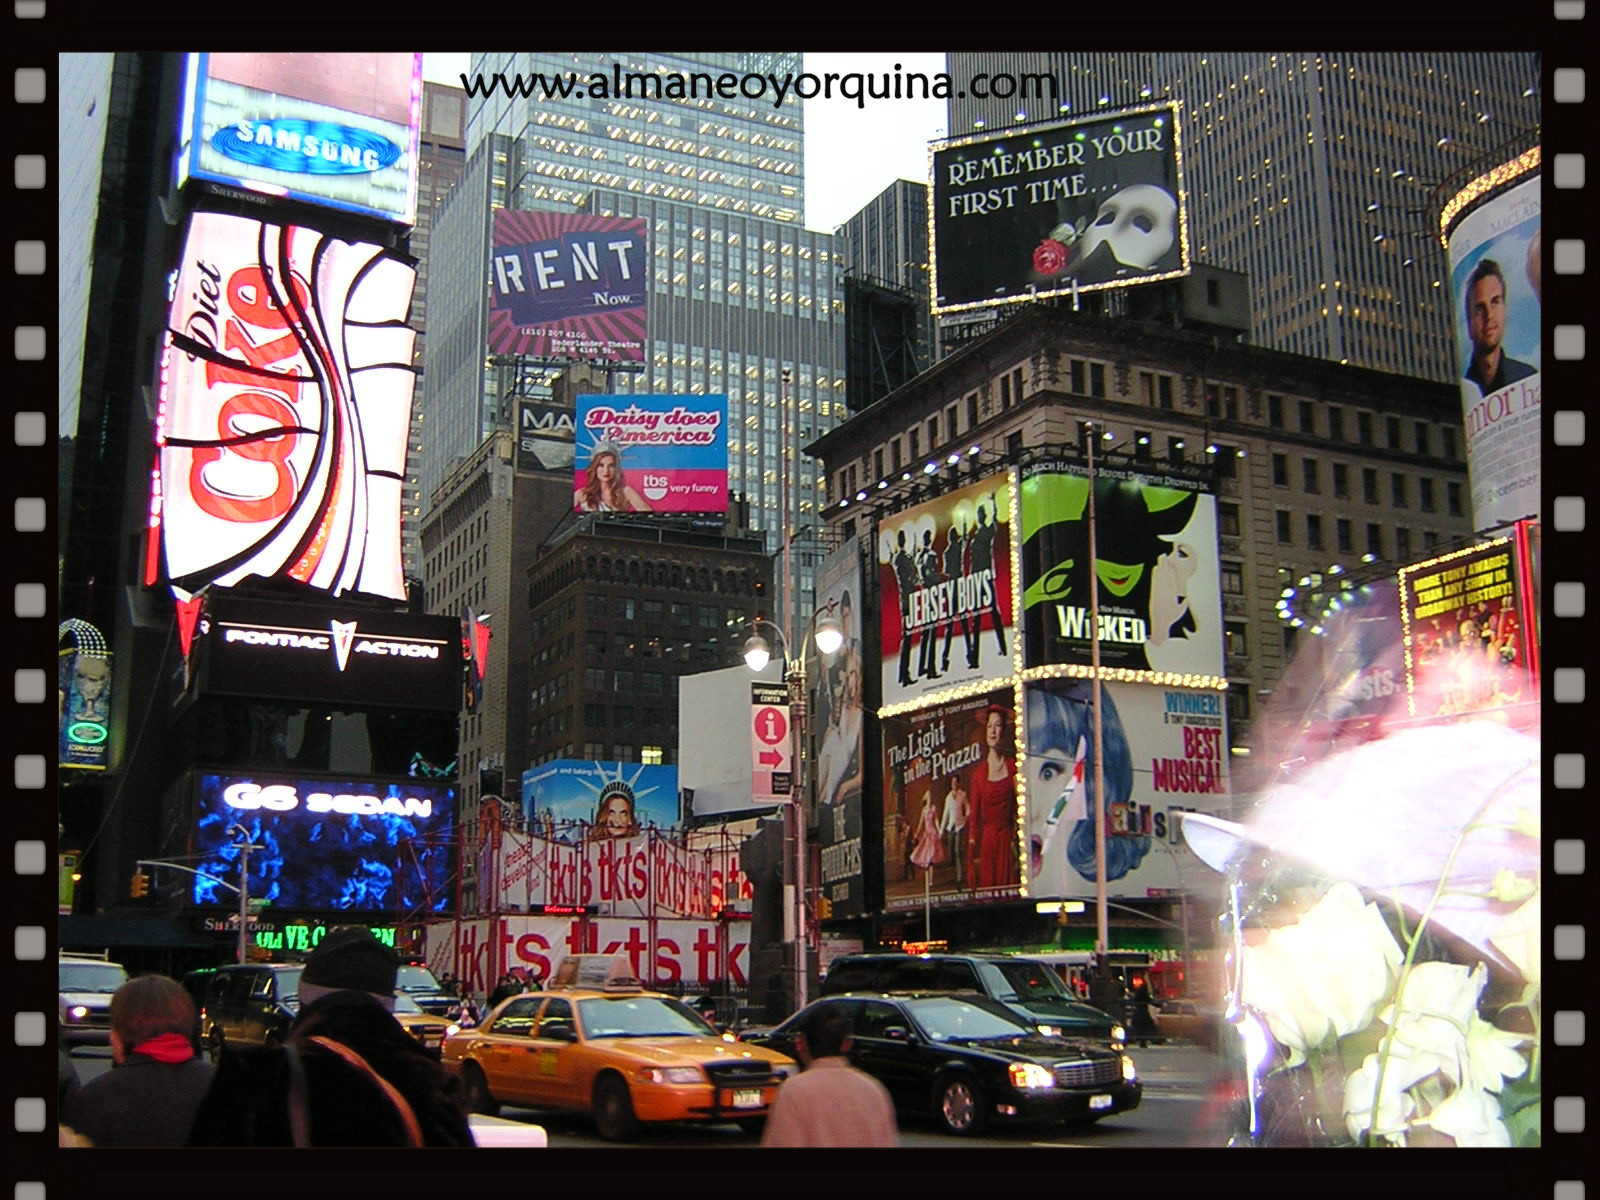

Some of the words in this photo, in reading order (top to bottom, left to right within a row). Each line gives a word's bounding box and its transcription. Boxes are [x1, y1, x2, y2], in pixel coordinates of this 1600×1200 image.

[236, 119, 381, 172] SAMSUNG
[949, 142, 1086, 186] REMEMBER
[1091, 128, 1164, 160] YOUR
[949, 185, 1018, 218] FIRST
[495, 239, 633, 295] RENT
[185, 259, 222, 362] Diet
[189, 265, 309, 524] Coke
[586, 408, 661, 428] Daisy
[664, 406, 718, 426] does
[608, 426, 711, 443] America
[643, 474, 668, 487] tbs
[670, 485, 692, 494] very
[692, 483, 718, 494] funny
[1442, 565, 1467, 584] TONY
[1468, 553, 1510, 576] AWARDS
[1464, 571, 1494, 591] SHOW
[905, 576, 955, 629] JERSEY
[957, 568, 993, 614] BOYS
[226, 629, 330, 651] PONTIAC
[355, 641, 439, 660] ACTION
[888, 745, 908, 768] The
[908, 720, 946, 760] Light
[1183, 725, 1222, 760] BEST
[903, 764, 915, 784] in
[915, 758, 931, 781] the
[931, 741, 981, 781] Piazza
[1152, 757, 1226, 794] MUSICAL
[223, 783, 299, 811] G6
[306, 791, 432, 818] SEDAN
[598, 840, 648, 900] tkts
[204, 917, 275, 932] SHEROOD
